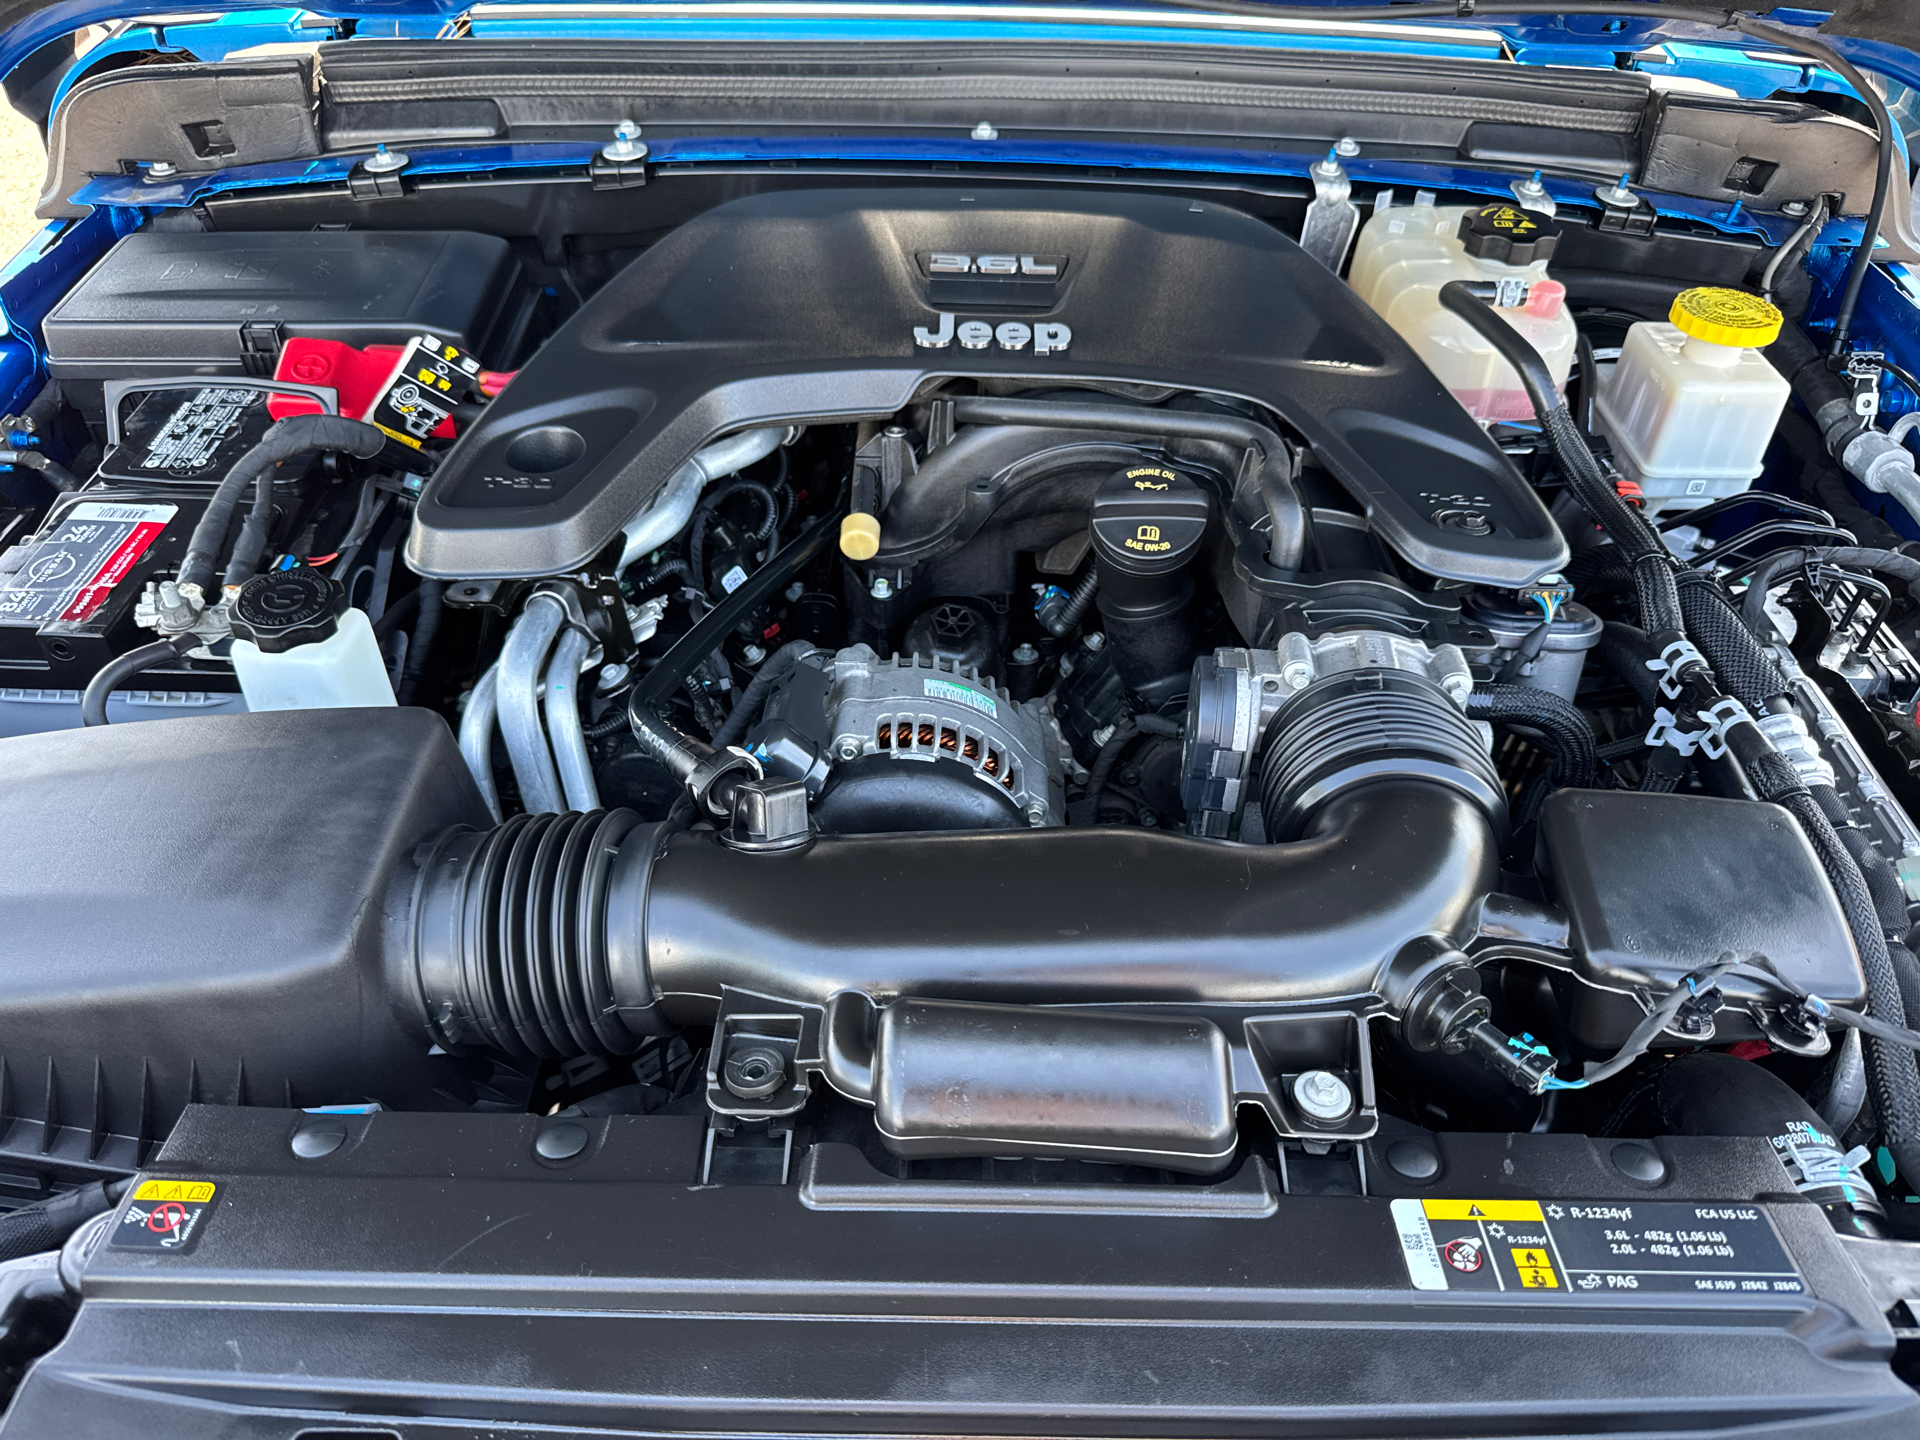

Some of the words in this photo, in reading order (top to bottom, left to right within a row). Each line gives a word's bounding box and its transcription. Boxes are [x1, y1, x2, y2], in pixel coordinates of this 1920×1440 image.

[930, 253, 1057, 275] 3.6L
[913, 312, 1072, 356] Jeep
[1126, 468, 1161, 479] ENGINE
[1162, 470, 1176, 481] OIL
[61, 525, 88, 542] 24
[1125, 538, 1143, 551] SAE
[1144, 541, 1171, 552] 0W-20
[37, 551, 70, 582] NISSAN
[0, 591, 29, 612] 84
[1785, 1121, 1811, 1133] RAD
[1571, 1207, 1632, 1221] R-1234yf
[1695, 1208, 1719, 1219] FCA
[1718, 1209, 1736, 1220] US
[1736, 1209, 1758, 1220] LLC
[1507, 1234, 1547, 1245] R-1234yf
[1604, 1229, 1631, 1240] 3.6L
[1644, 1230, 1674, 1243] 482g
[1676, 1230, 1707, 1243] (1.06
[1706, 1231, 1727, 1244] Lb)
[1610, 1243, 1637, 1255] 2.0L
[1650, 1244, 1680, 1257] 482g
[1683, 1244, 1713, 1257] (1.06
[1713, 1245, 1734, 1258] Lb)
[1606, 1275, 1639, 1288] PAG
[1695, 1280, 1714, 1290] SAE
